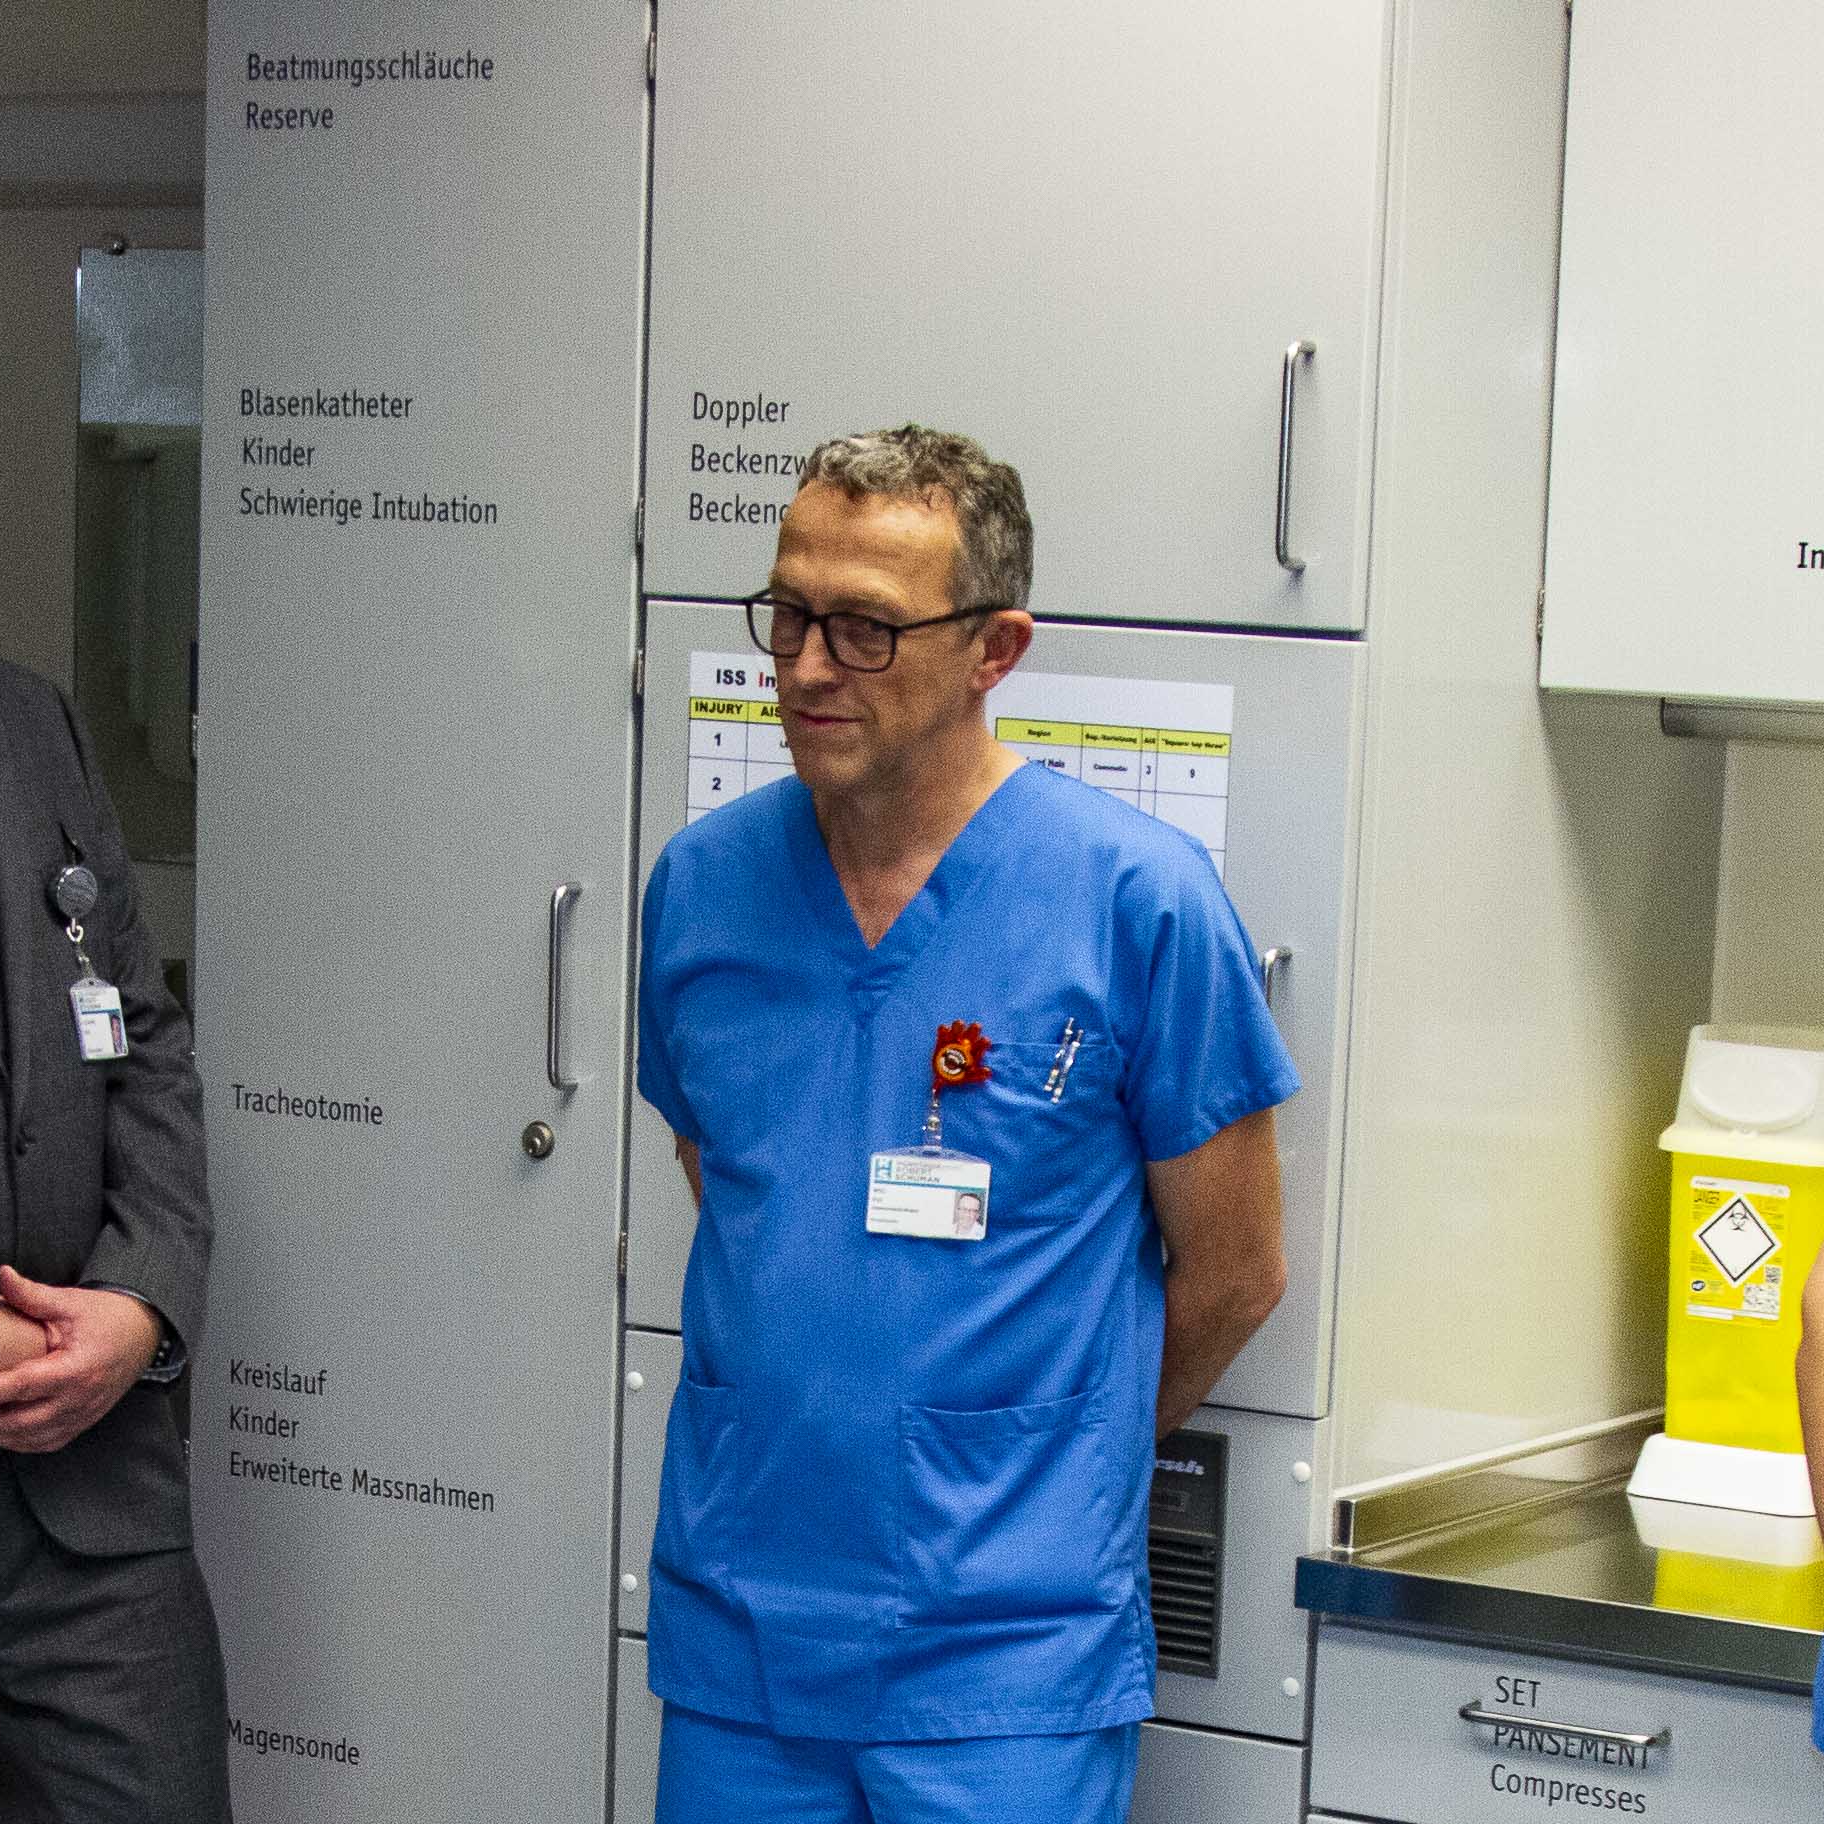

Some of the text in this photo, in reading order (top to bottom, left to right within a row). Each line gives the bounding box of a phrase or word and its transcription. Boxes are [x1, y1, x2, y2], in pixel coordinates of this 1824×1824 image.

[247, 52, 494, 87] Beatmungsschläuche
[246, 102, 334, 129] Reserve
[240, 388, 413, 418] Blasenkatheter
[693, 392, 790, 429] Doppler
[242, 438, 315, 467] Kinder
[691, 444, 807, 475] Beckenzw
[240, 487, 498, 526] Schwierige Intubation
[716, 669, 746, 686] ISS
[694, 701, 743, 715] INJURY
[713, 732, 721, 747] 1
[712, 777, 721, 791] 2
[231, 1083, 384, 1126] Tracheotomie
[230, 1358, 328, 1396] Kreislauf
[229, 1405, 300, 1440] Kinder
[230, 1451, 496, 1513] Erweiterte Massnahmen
[1494, 1676, 1541, 1708] SET
[227, 1717, 361, 1766] Magensonde
[1490, 1763, 1647, 1814] Compresses
